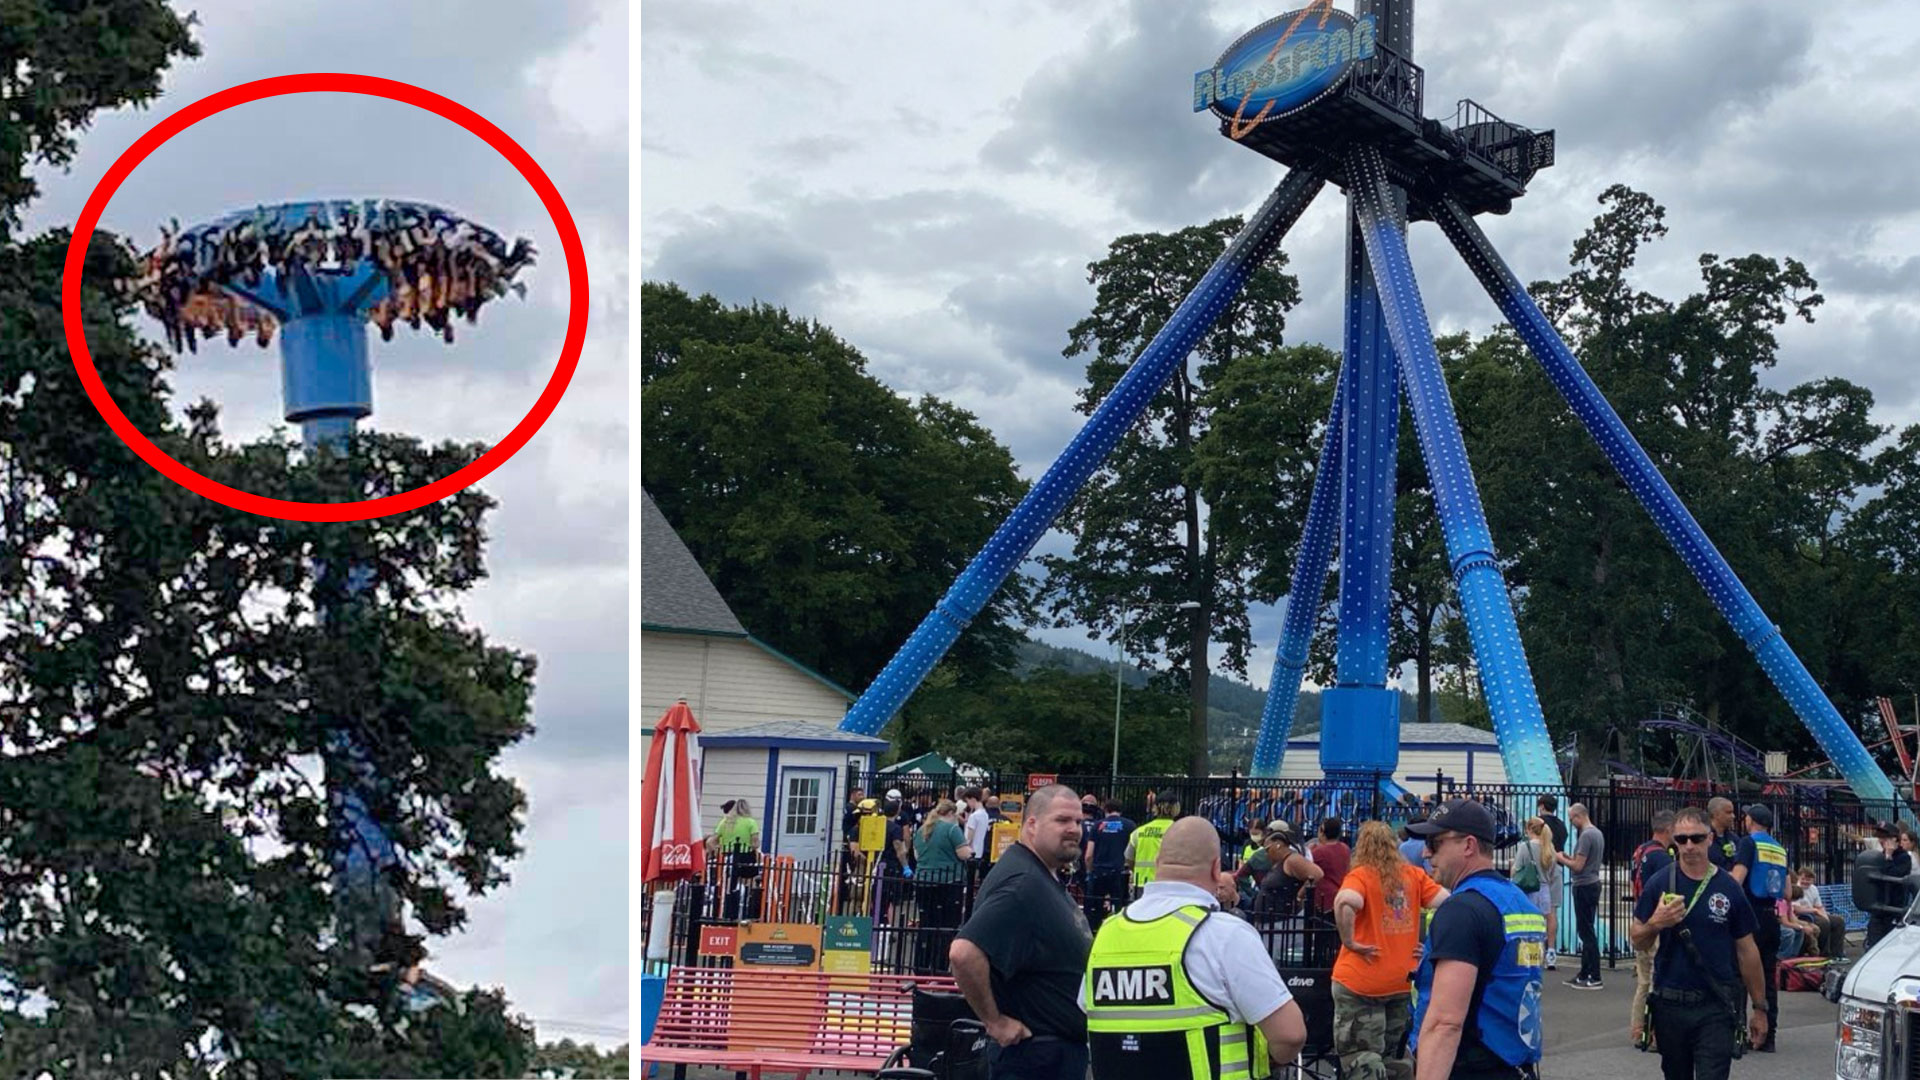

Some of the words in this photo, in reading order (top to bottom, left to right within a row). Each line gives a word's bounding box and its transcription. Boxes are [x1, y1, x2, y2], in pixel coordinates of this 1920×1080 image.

[709, 936, 731, 946] EXIT
[1095, 968, 1170, 1000] AMR
[1287, 975, 1315, 987] drive
